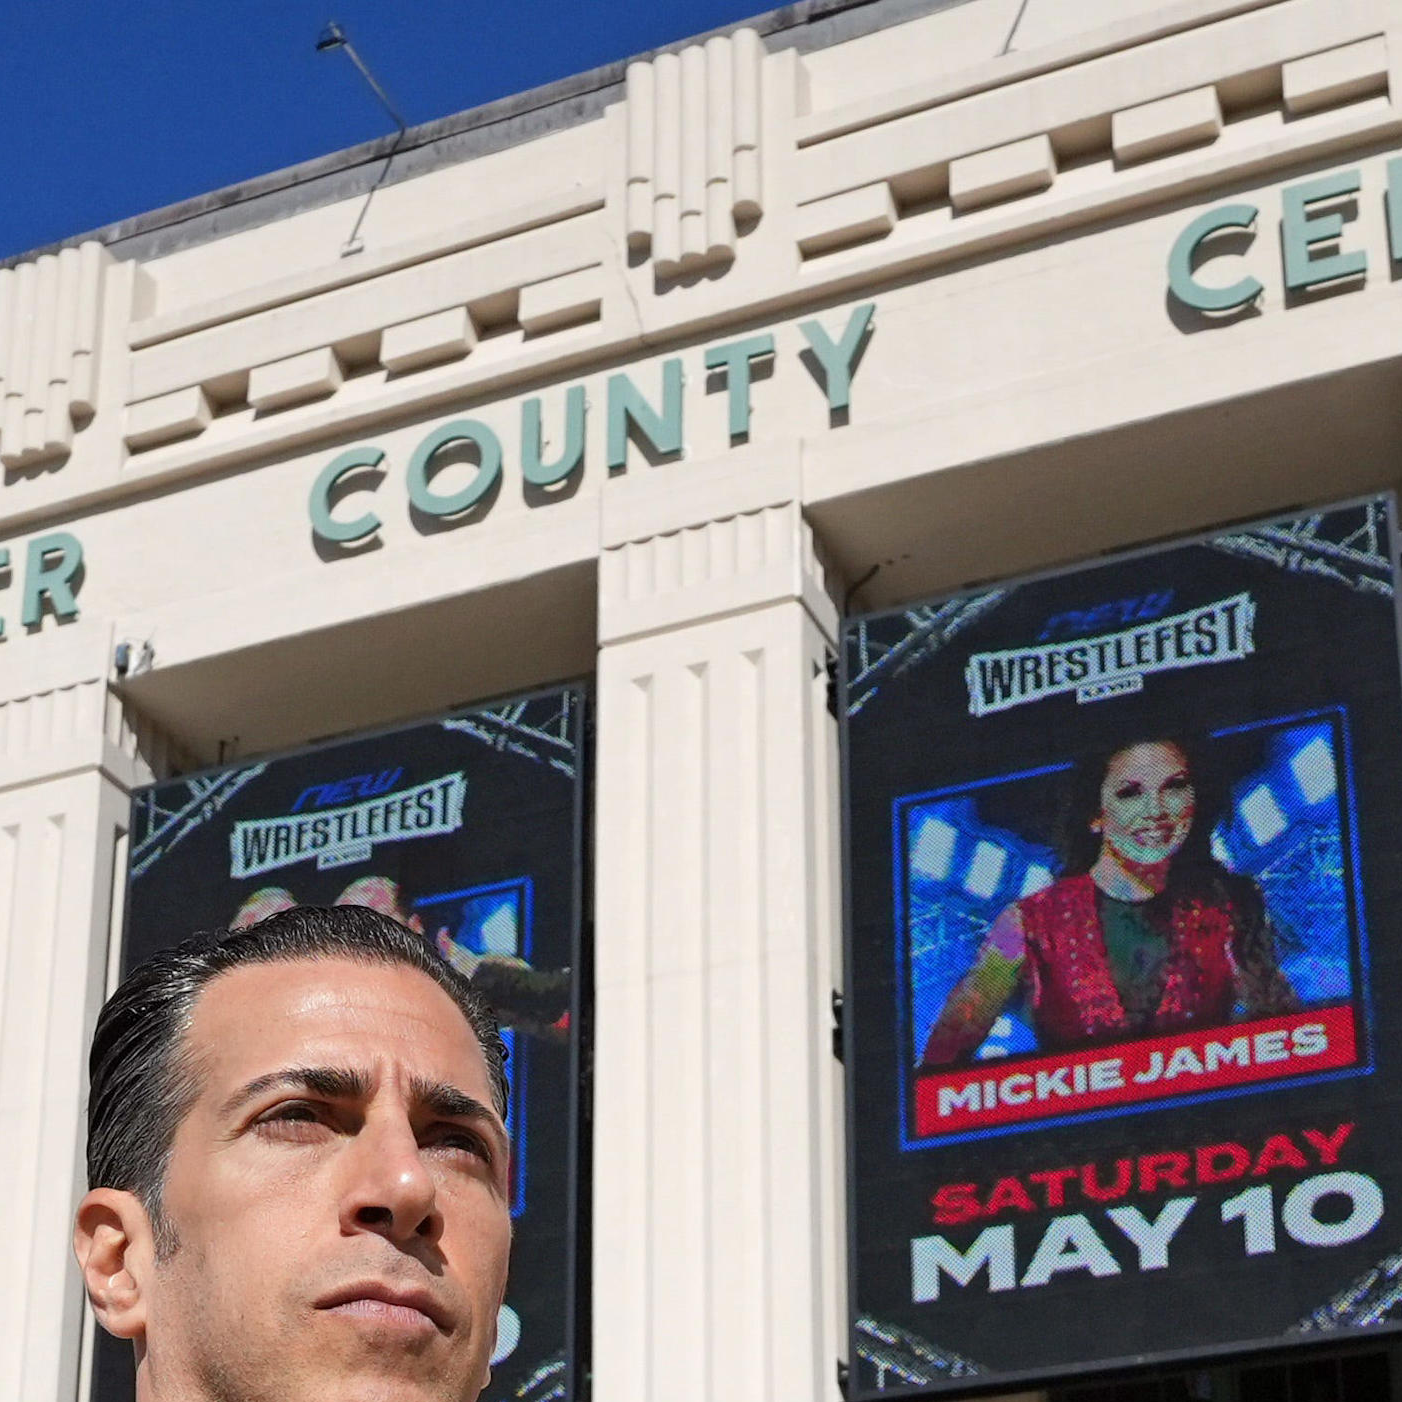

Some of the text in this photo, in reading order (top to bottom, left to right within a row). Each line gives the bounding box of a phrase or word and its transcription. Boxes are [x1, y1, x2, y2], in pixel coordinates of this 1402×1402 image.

[309, 303, 875, 541] COUNTY
[978, 602, 1241, 704] WRESTLEFEST
[242, 780, 455, 869] WRESTLEFEST
[938, 1023, 1328, 1117] MICKIE JAMES
[932, 1123, 1355, 1225] SATURDAY
[910, 1171, 1384, 1303] MAY 10
